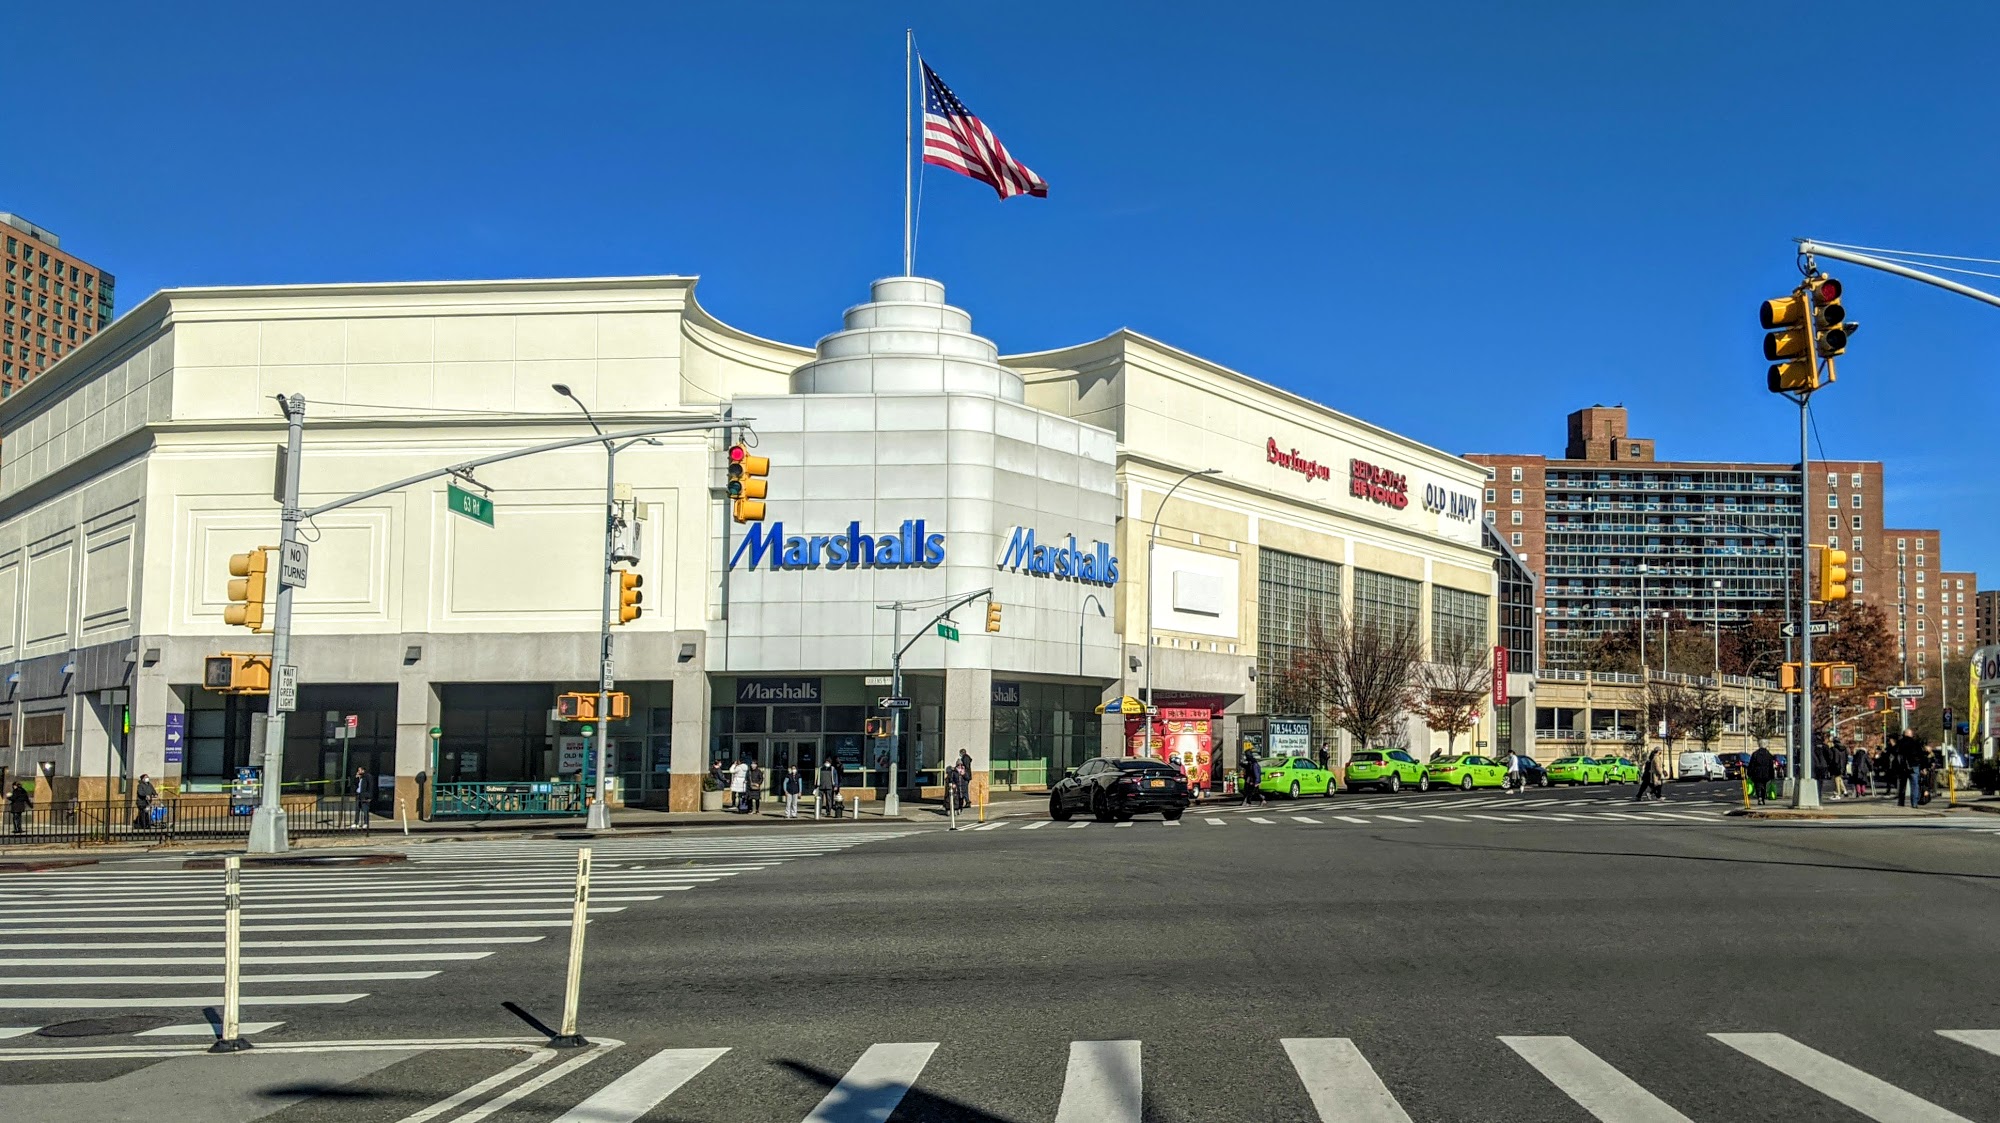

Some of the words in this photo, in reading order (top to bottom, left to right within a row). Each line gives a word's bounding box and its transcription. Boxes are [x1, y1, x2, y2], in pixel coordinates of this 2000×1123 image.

[1267, 437, 1330, 482] Burlington
[1352, 459, 1372, 480] BED
[1352, 479, 1408, 507] BEYOND
[1426, 483, 1446, 510] OLD
[1450, 491, 1477, 520] NAVY
[463, 495, 471, 512] 63
[472, 498, 480, 516] Rd
[729, 519, 945, 570] Marshalls
[290, 548, 301, 562] NO
[1000, 526, 1119, 584] Marshalls
[284, 565, 305, 580] TURNS
[283, 668, 294, 676] WAIT
[283, 678, 293, 686] FOR
[740, 682, 817, 699] Marshalls
[280, 687, 294, 696] GREEN
[991, 686, 1018, 702] rshalls
[280, 698, 293, 707] LIGHT
